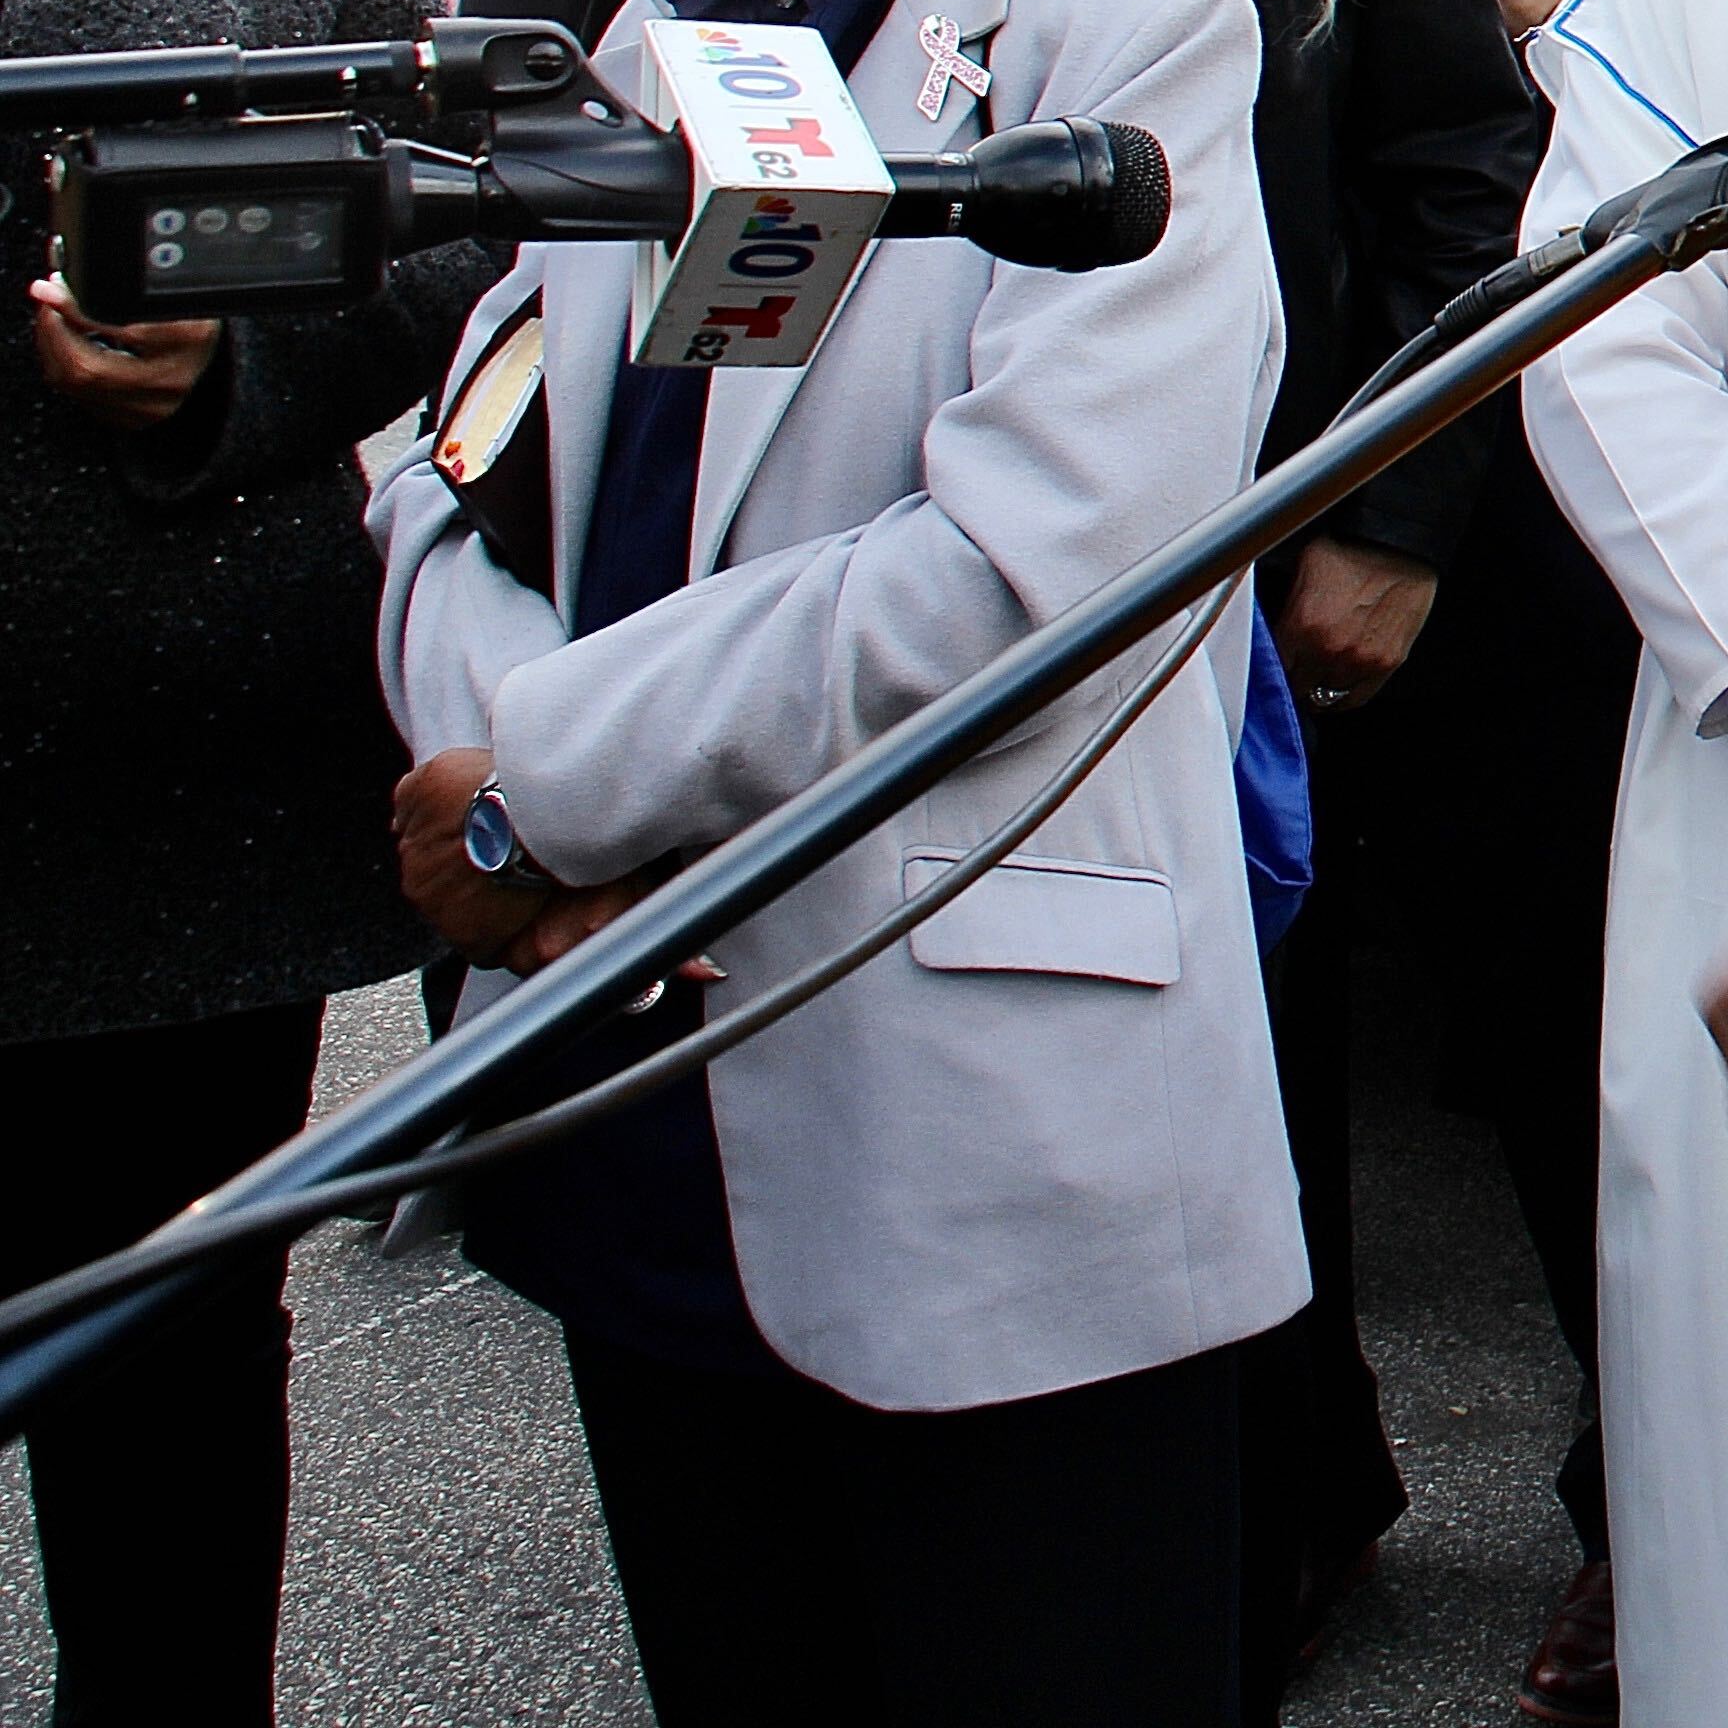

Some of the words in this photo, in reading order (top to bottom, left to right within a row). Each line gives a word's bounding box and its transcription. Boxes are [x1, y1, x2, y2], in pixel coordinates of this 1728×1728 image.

[696, 52, 802, 100] 10
[752, 150, 799, 180] 62
[728, 223, 824, 279] 10
[683, 332, 731, 363] 62
